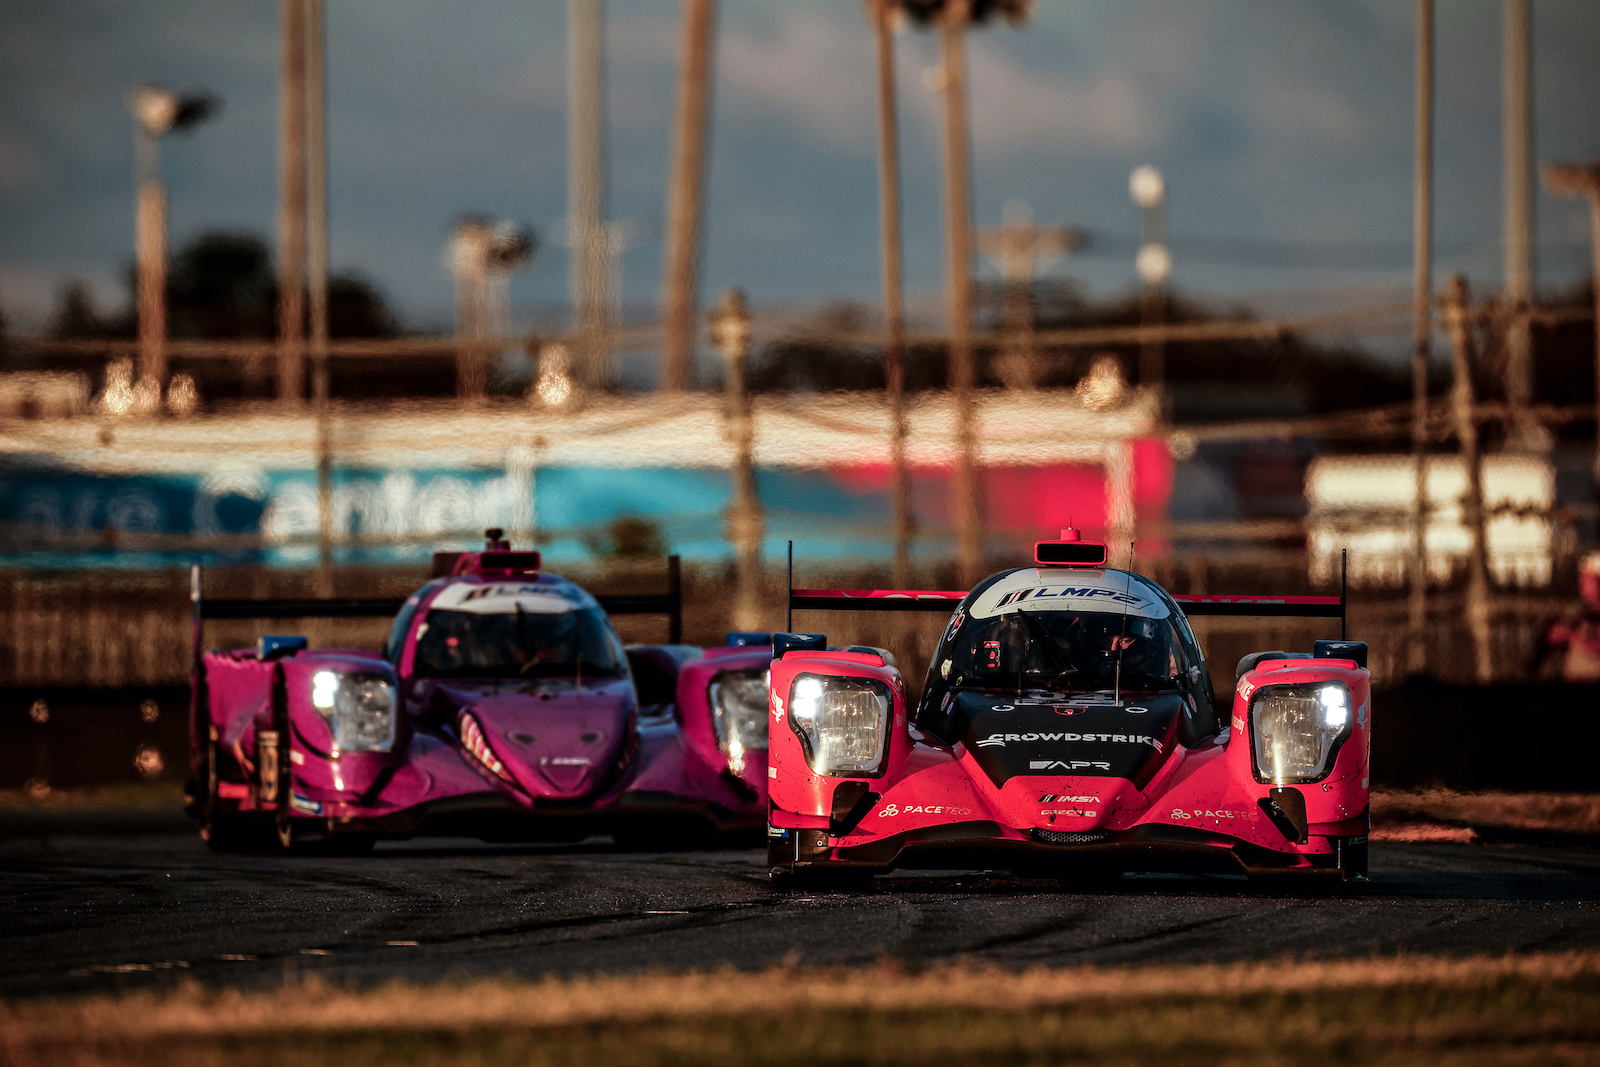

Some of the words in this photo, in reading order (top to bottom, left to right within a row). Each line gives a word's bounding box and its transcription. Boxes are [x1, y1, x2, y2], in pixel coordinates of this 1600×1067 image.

[1034, 587, 1142, 605] LMP2
[976, 733, 1164, 754] CROWDSTRIKE
[1057, 795, 1101, 803] IMSA
